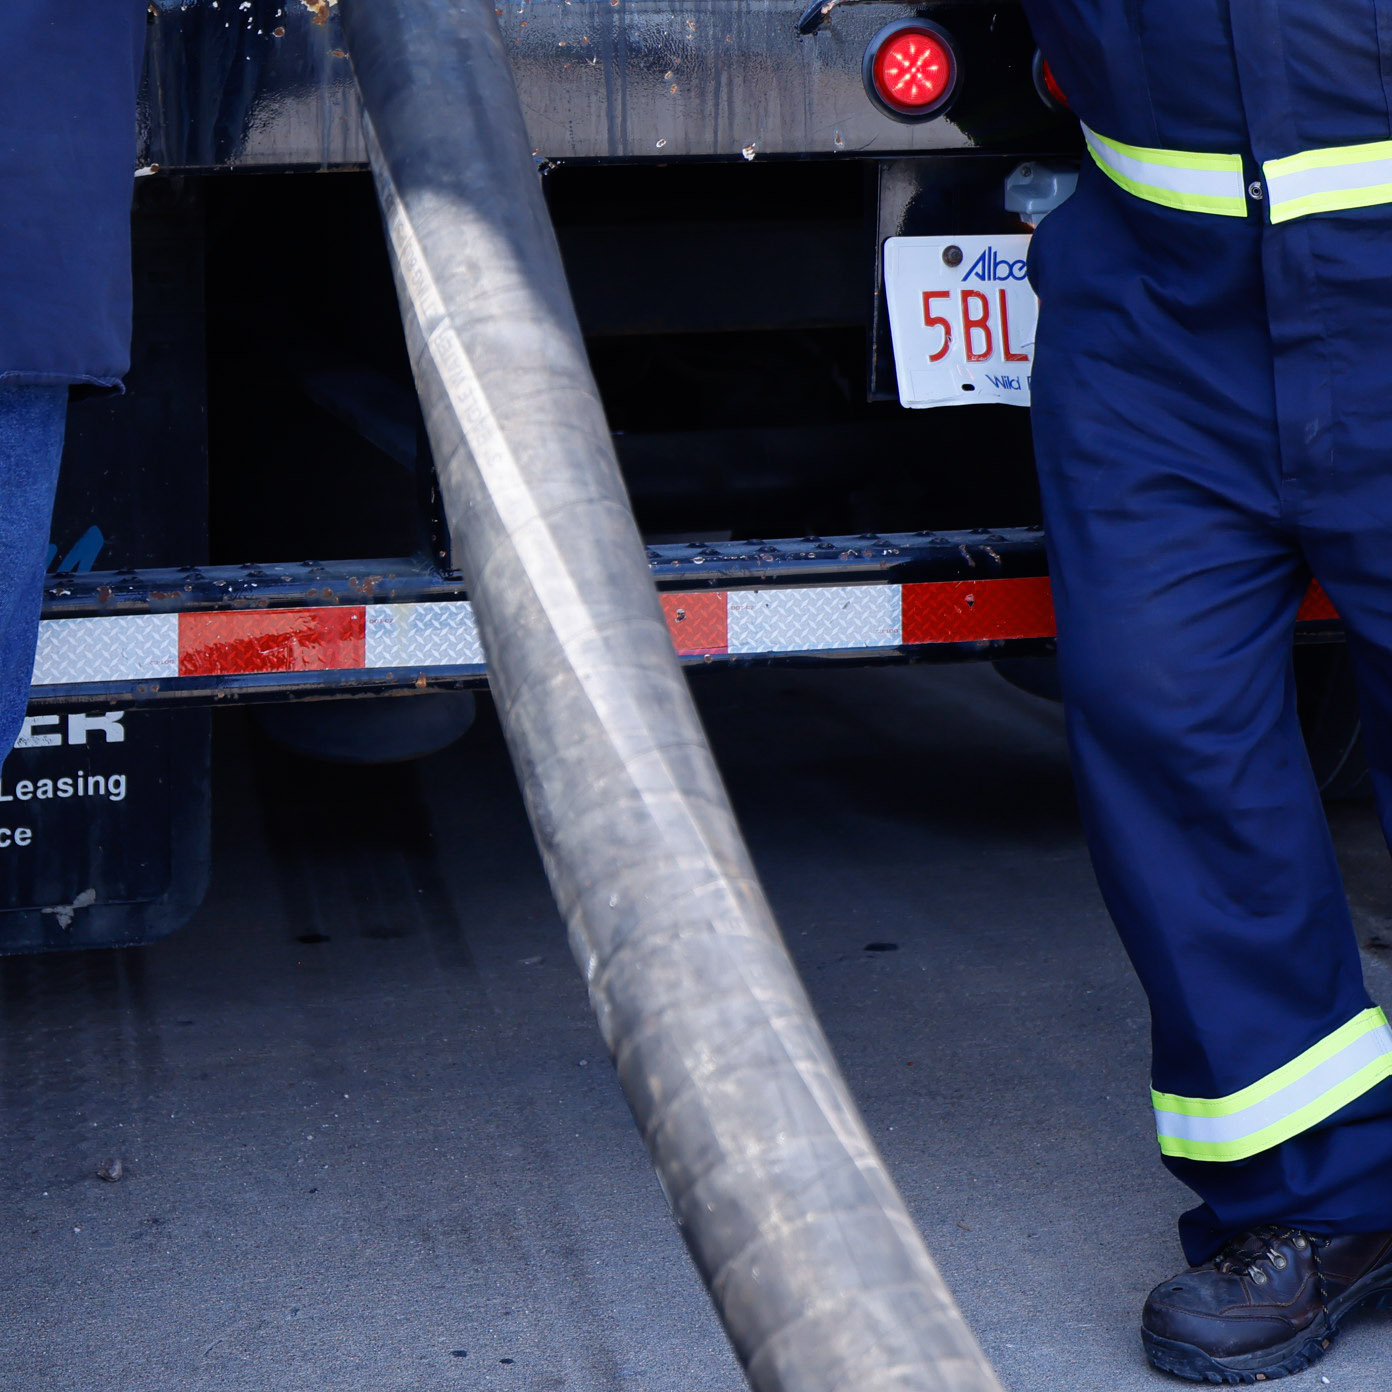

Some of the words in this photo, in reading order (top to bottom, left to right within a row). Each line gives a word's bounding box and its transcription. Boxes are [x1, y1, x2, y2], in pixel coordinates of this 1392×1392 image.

[961, 246, 1028, 282] Albe
[922, 289, 1030, 363] 5BL
[985, 374, 1021, 390] Wild
